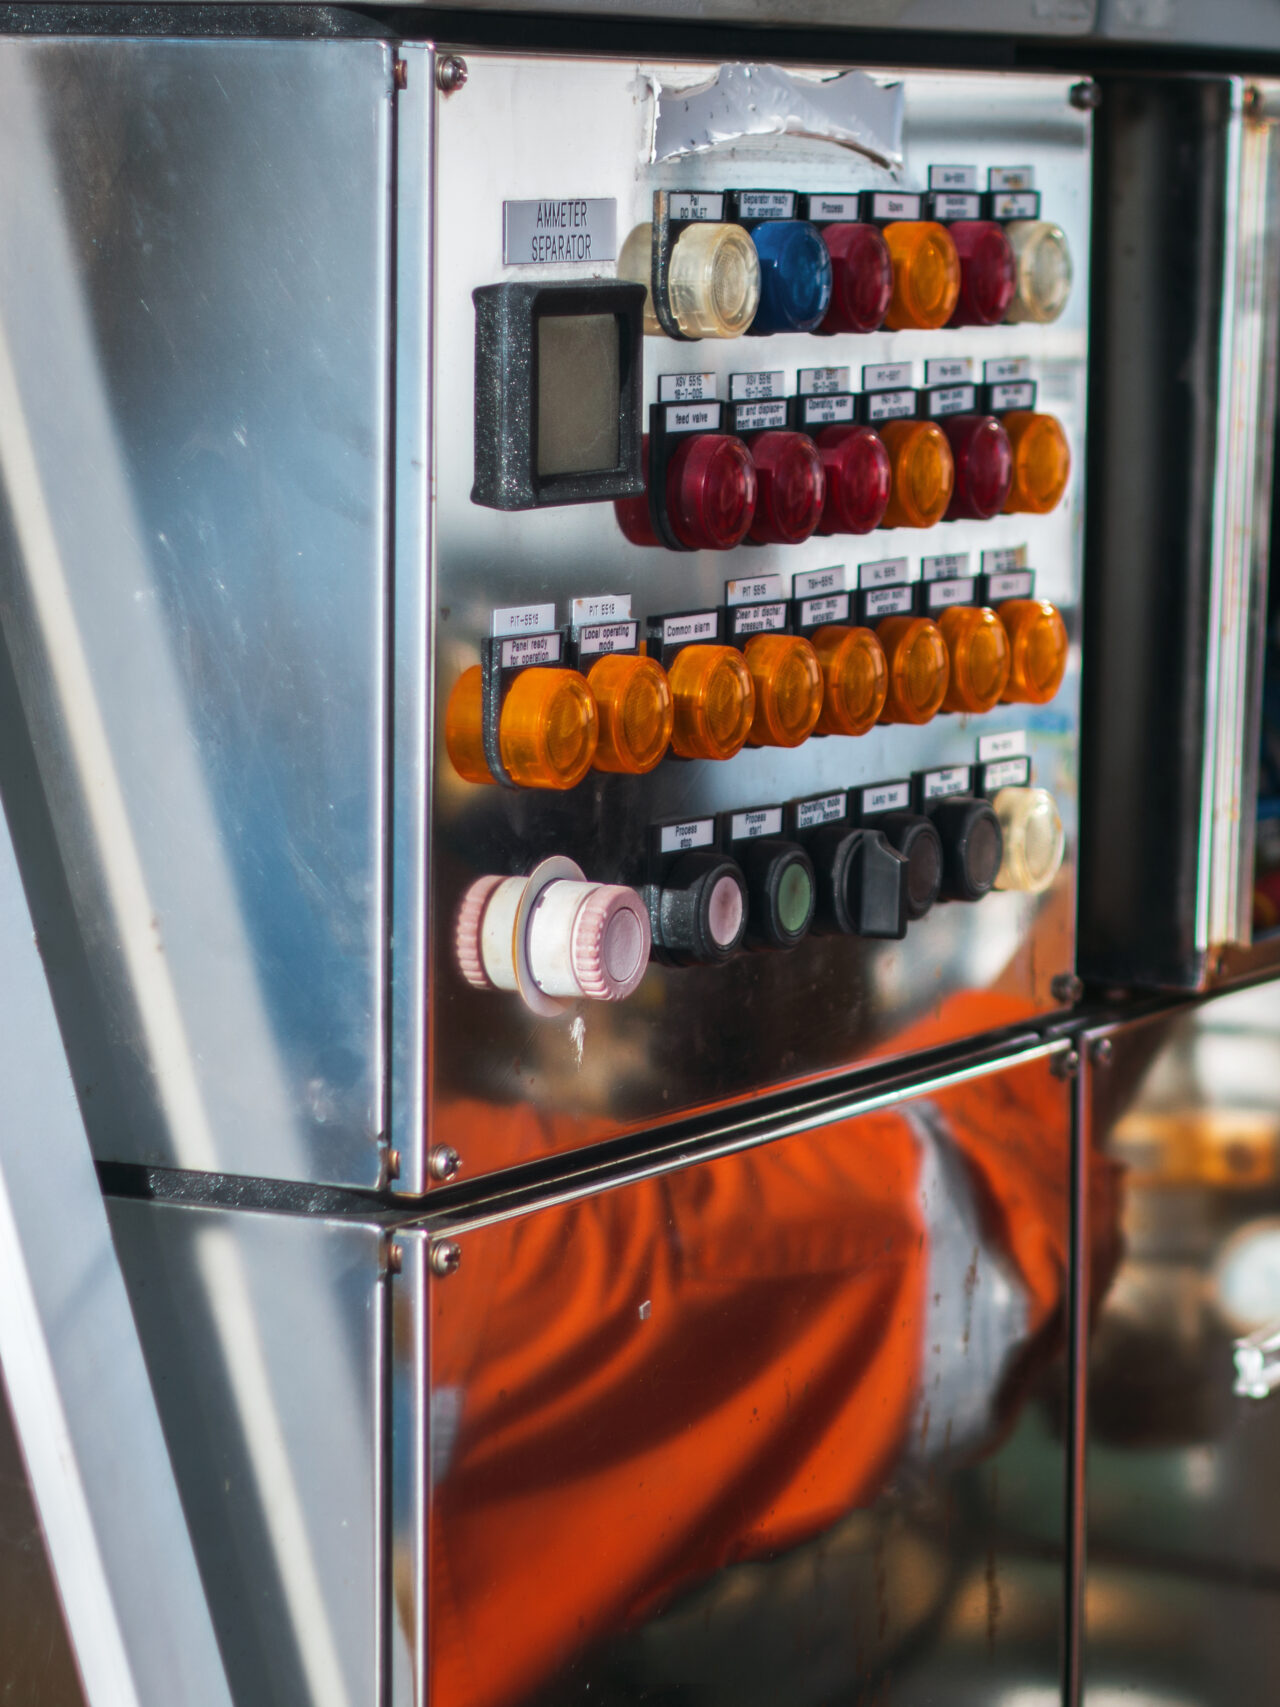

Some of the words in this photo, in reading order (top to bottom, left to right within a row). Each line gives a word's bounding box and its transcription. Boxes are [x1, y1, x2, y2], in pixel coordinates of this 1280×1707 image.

[536, 200, 588, 229] AMMETER
[691, 207, 708, 219] INLET
[531, 233, 592, 262] SEPARATOR
[675, 412, 690, 425] feed
[692, 411, 708, 424] valve
[742, 585, 752, 598] PIT
[589, 605, 599, 617] PIT
[584, 627, 601, 640] Local
[602, 625, 630, 639] operating
[667, 624, 692, 637] Common
[694, 622, 711, 634] alarm
[512, 640, 528, 653] Panel
[530, 637, 548, 650] ready
[598, 641, 615, 651] mode
[510, 655, 521, 666] for
[522, 650, 550, 665] operation
[745, 812, 767, 825] Process
[675, 824, 698, 838] Process
[748, 825, 762, 836] start
[680, 838, 693, 849] stop
